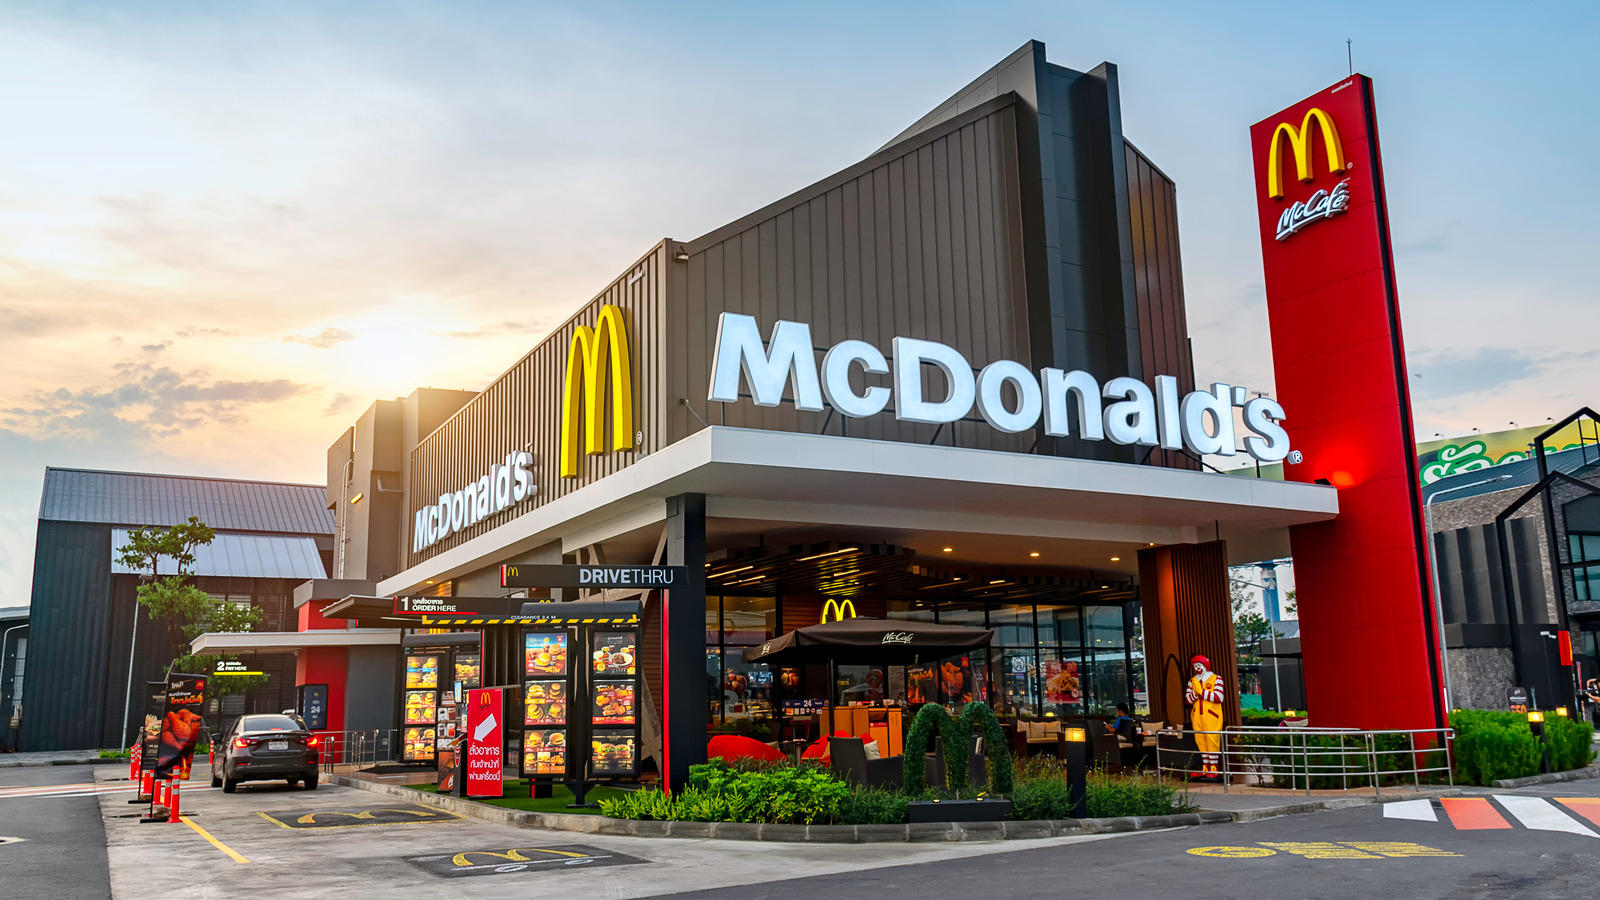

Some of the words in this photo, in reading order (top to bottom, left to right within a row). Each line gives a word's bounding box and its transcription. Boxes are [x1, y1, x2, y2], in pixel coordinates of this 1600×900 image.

[1275, 177, 1350, 240] McCafé
[707, 311, 1291, 462] McDonald's
[413, 450, 535, 554] McDonald's
[401, 596, 409, 611] 1
[216, 661, 225, 671] 2
[469, 742, 500, 756] สั่งอาหาร
